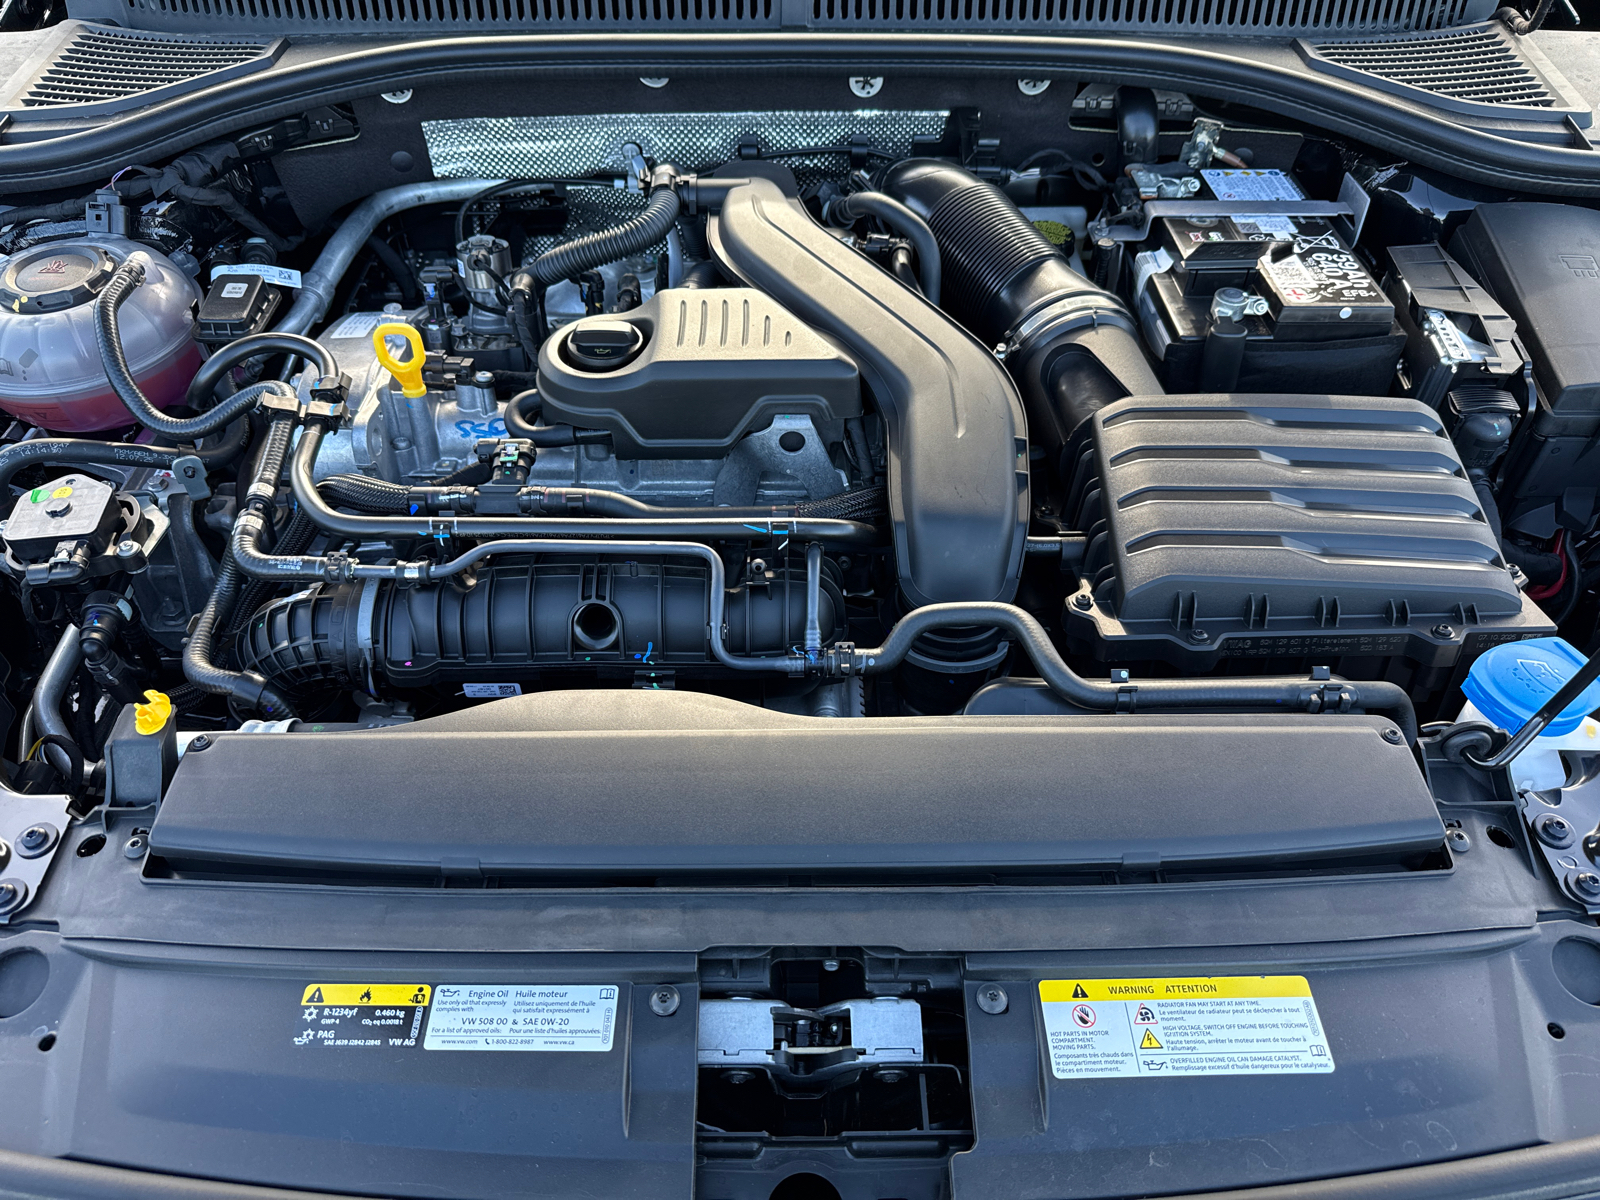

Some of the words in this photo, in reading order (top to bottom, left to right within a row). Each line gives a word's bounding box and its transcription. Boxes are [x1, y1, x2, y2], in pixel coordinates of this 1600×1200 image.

[1312, 253, 1344, 276] 640
[1330, 278, 1352, 289] A
[1332, 254, 1370, 288] 59Ah
[1342, 290, 1377, 298] EFB+
[1108, 985, 1154, 994] WARNING
[1166, 984, 1218, 994] ATTENTION
[468, 990, 496, 999] Engine
[516, 990, 536, 998] Huile
[323, 1008, 358, 1018] R-1234yf
[396, 1009, 406, 1018] kg
[317, 1030, 336, 1038] PAG
